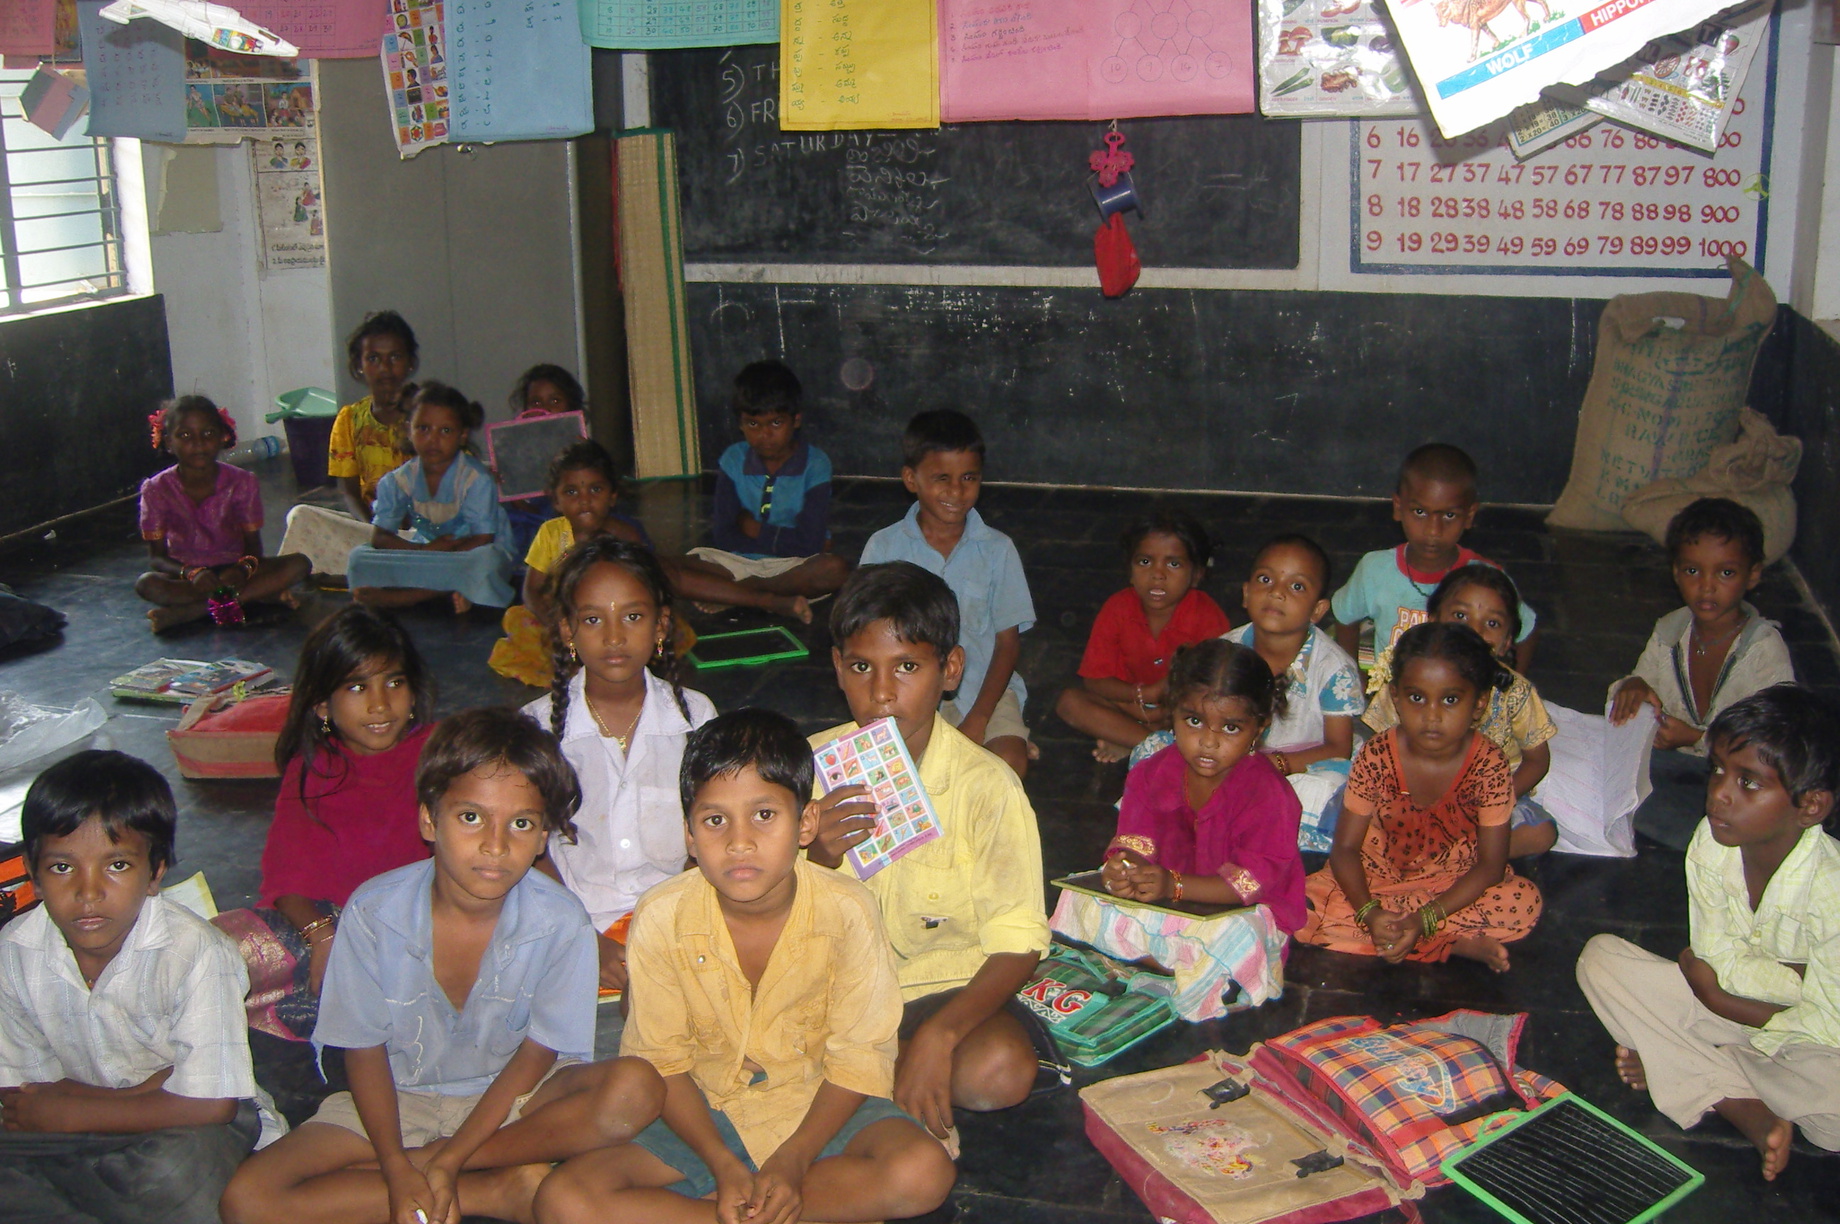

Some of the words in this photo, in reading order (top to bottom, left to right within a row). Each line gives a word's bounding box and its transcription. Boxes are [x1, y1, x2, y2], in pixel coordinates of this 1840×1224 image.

[1485, 43, 1534, 75] WOLF
[722, 63, 746, 105] 5)
[726, 101, 745, 142] 6)
[753, 133, 875, 167] SATURDAY
[1366, 128, 1381, 149] 6
[1397, 127, 1420, 148] 16
[1601, 128, 1624, 149] 76
[1367, 159, 1382, 180] 7
[1397, 163, 1421, 182] 17
[1429, 163, 1457, 184] 27
[1463, 163, 1490, 182] 37
[1497, 164, 1525, 185] 47
[1532, 165, 1559, 186] 57
[1564, 165, 1593, 185] 67
[1601, 165, 1626, 184] 77
[1632, 165, 1661, 187] 87
[1663, 165, 1695, 187] 97
[1703, 167, 1741, 188] 800
[1367, 194, 1383, 217] 8
[1397, 197, 1421, 218] 18
[1431, 197, 1459, 219] 28
[1462, 197, 1491, 219] 38
[1497, 199, 1525, 221] 48
[1532, 199, 1558, 219] 58
[1563, 200, 1590, 220] 68
[1599, 201, 1625, 221] 78
[1631, 202, 1659, 222] 88
[1662, 204, 1692, 223] 98
[1701, 205, 1740, 224] 900
[1366, 230, 1383, 252] 9
[1396, 232, 1423, 254] 19
[1431, 232, 1459, 254] 29
[1463, 234, 1490, 254] 39
[1497, 236, 1524, 256] 49
[1531, 237, 1557, 257] 59
[1563, 237, 1589, 257] 69
[1597, 236, 1624, 256] 79
[1629, 236, 1659, 256] 89
[1660, 236, 1692, 256] 99
[1699, 238, 1747, 258] 1000
